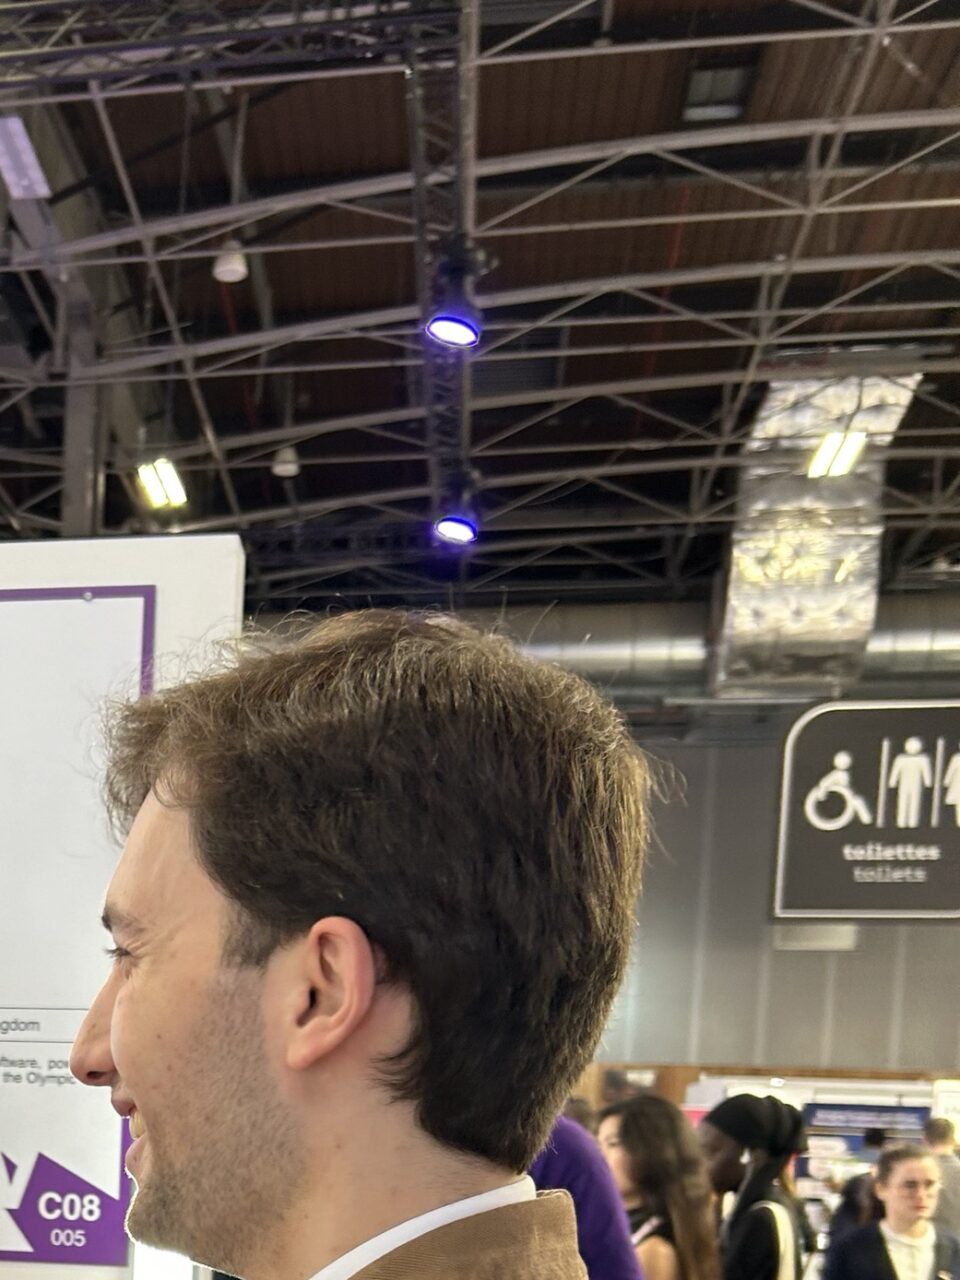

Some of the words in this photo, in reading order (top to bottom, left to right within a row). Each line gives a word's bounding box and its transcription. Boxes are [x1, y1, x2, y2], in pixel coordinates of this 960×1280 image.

[843, 841, 940, 861] toilettes
[853, 865, 927, 883] toilets
[2, 1071, 23, 1084] the
[26, 1071, 77, 1088] Olympic
[38, 1191, 102, 1222] C08
[50, 1228, 87, 1248] 005
